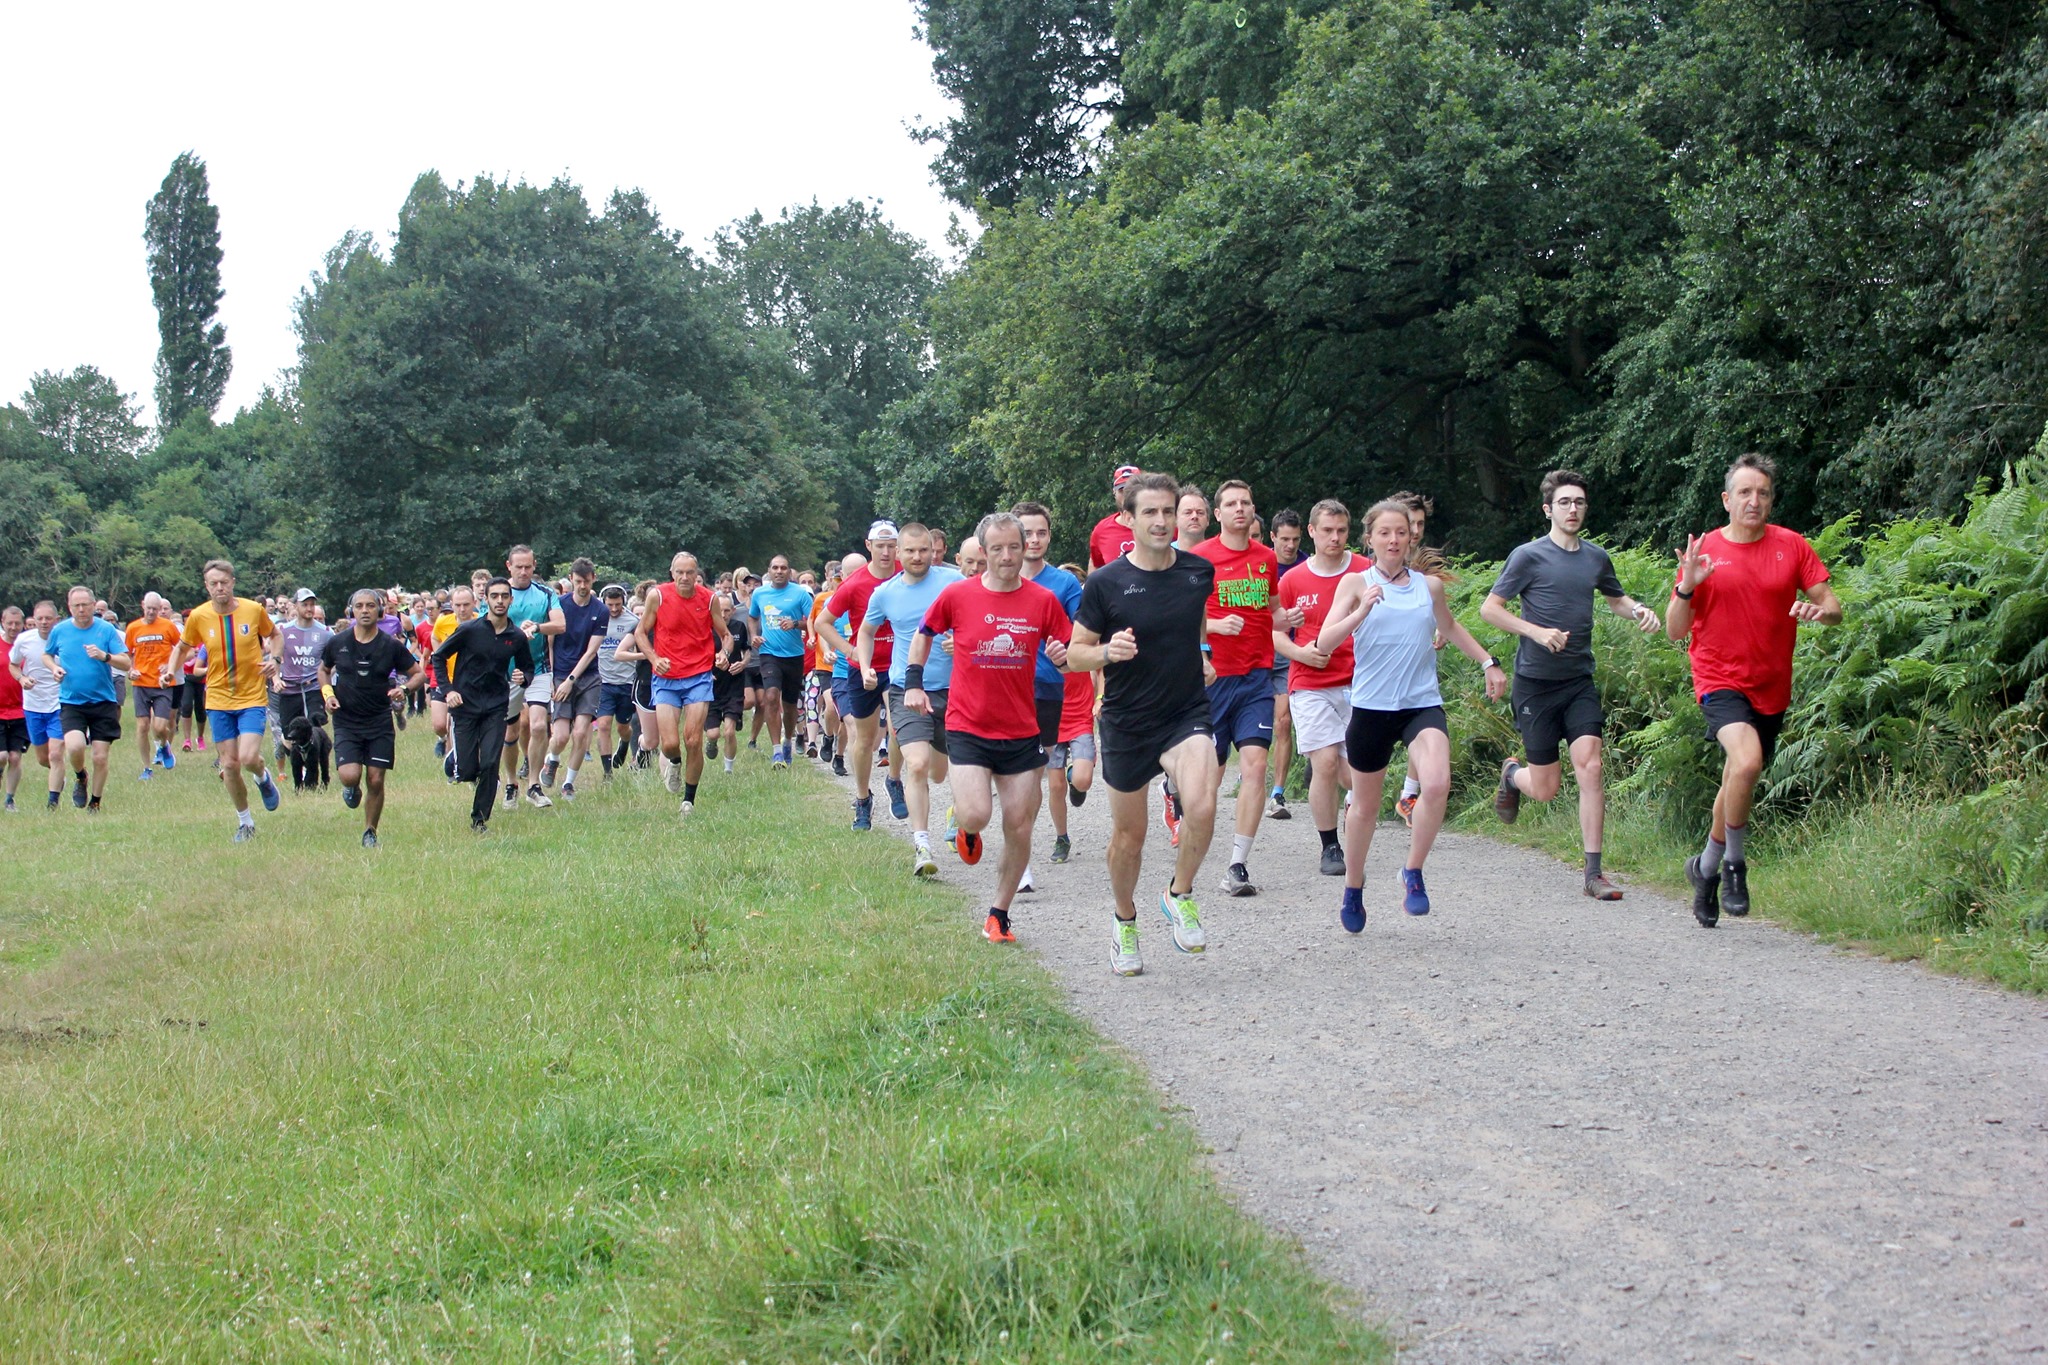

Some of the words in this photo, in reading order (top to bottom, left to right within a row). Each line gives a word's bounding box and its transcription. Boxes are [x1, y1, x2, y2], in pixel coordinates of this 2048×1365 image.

[1124, 584, 1146, 595] parkrun
[1219, 591, 1270, 608] FINISHER
[291, 656, 316, 667] W88
